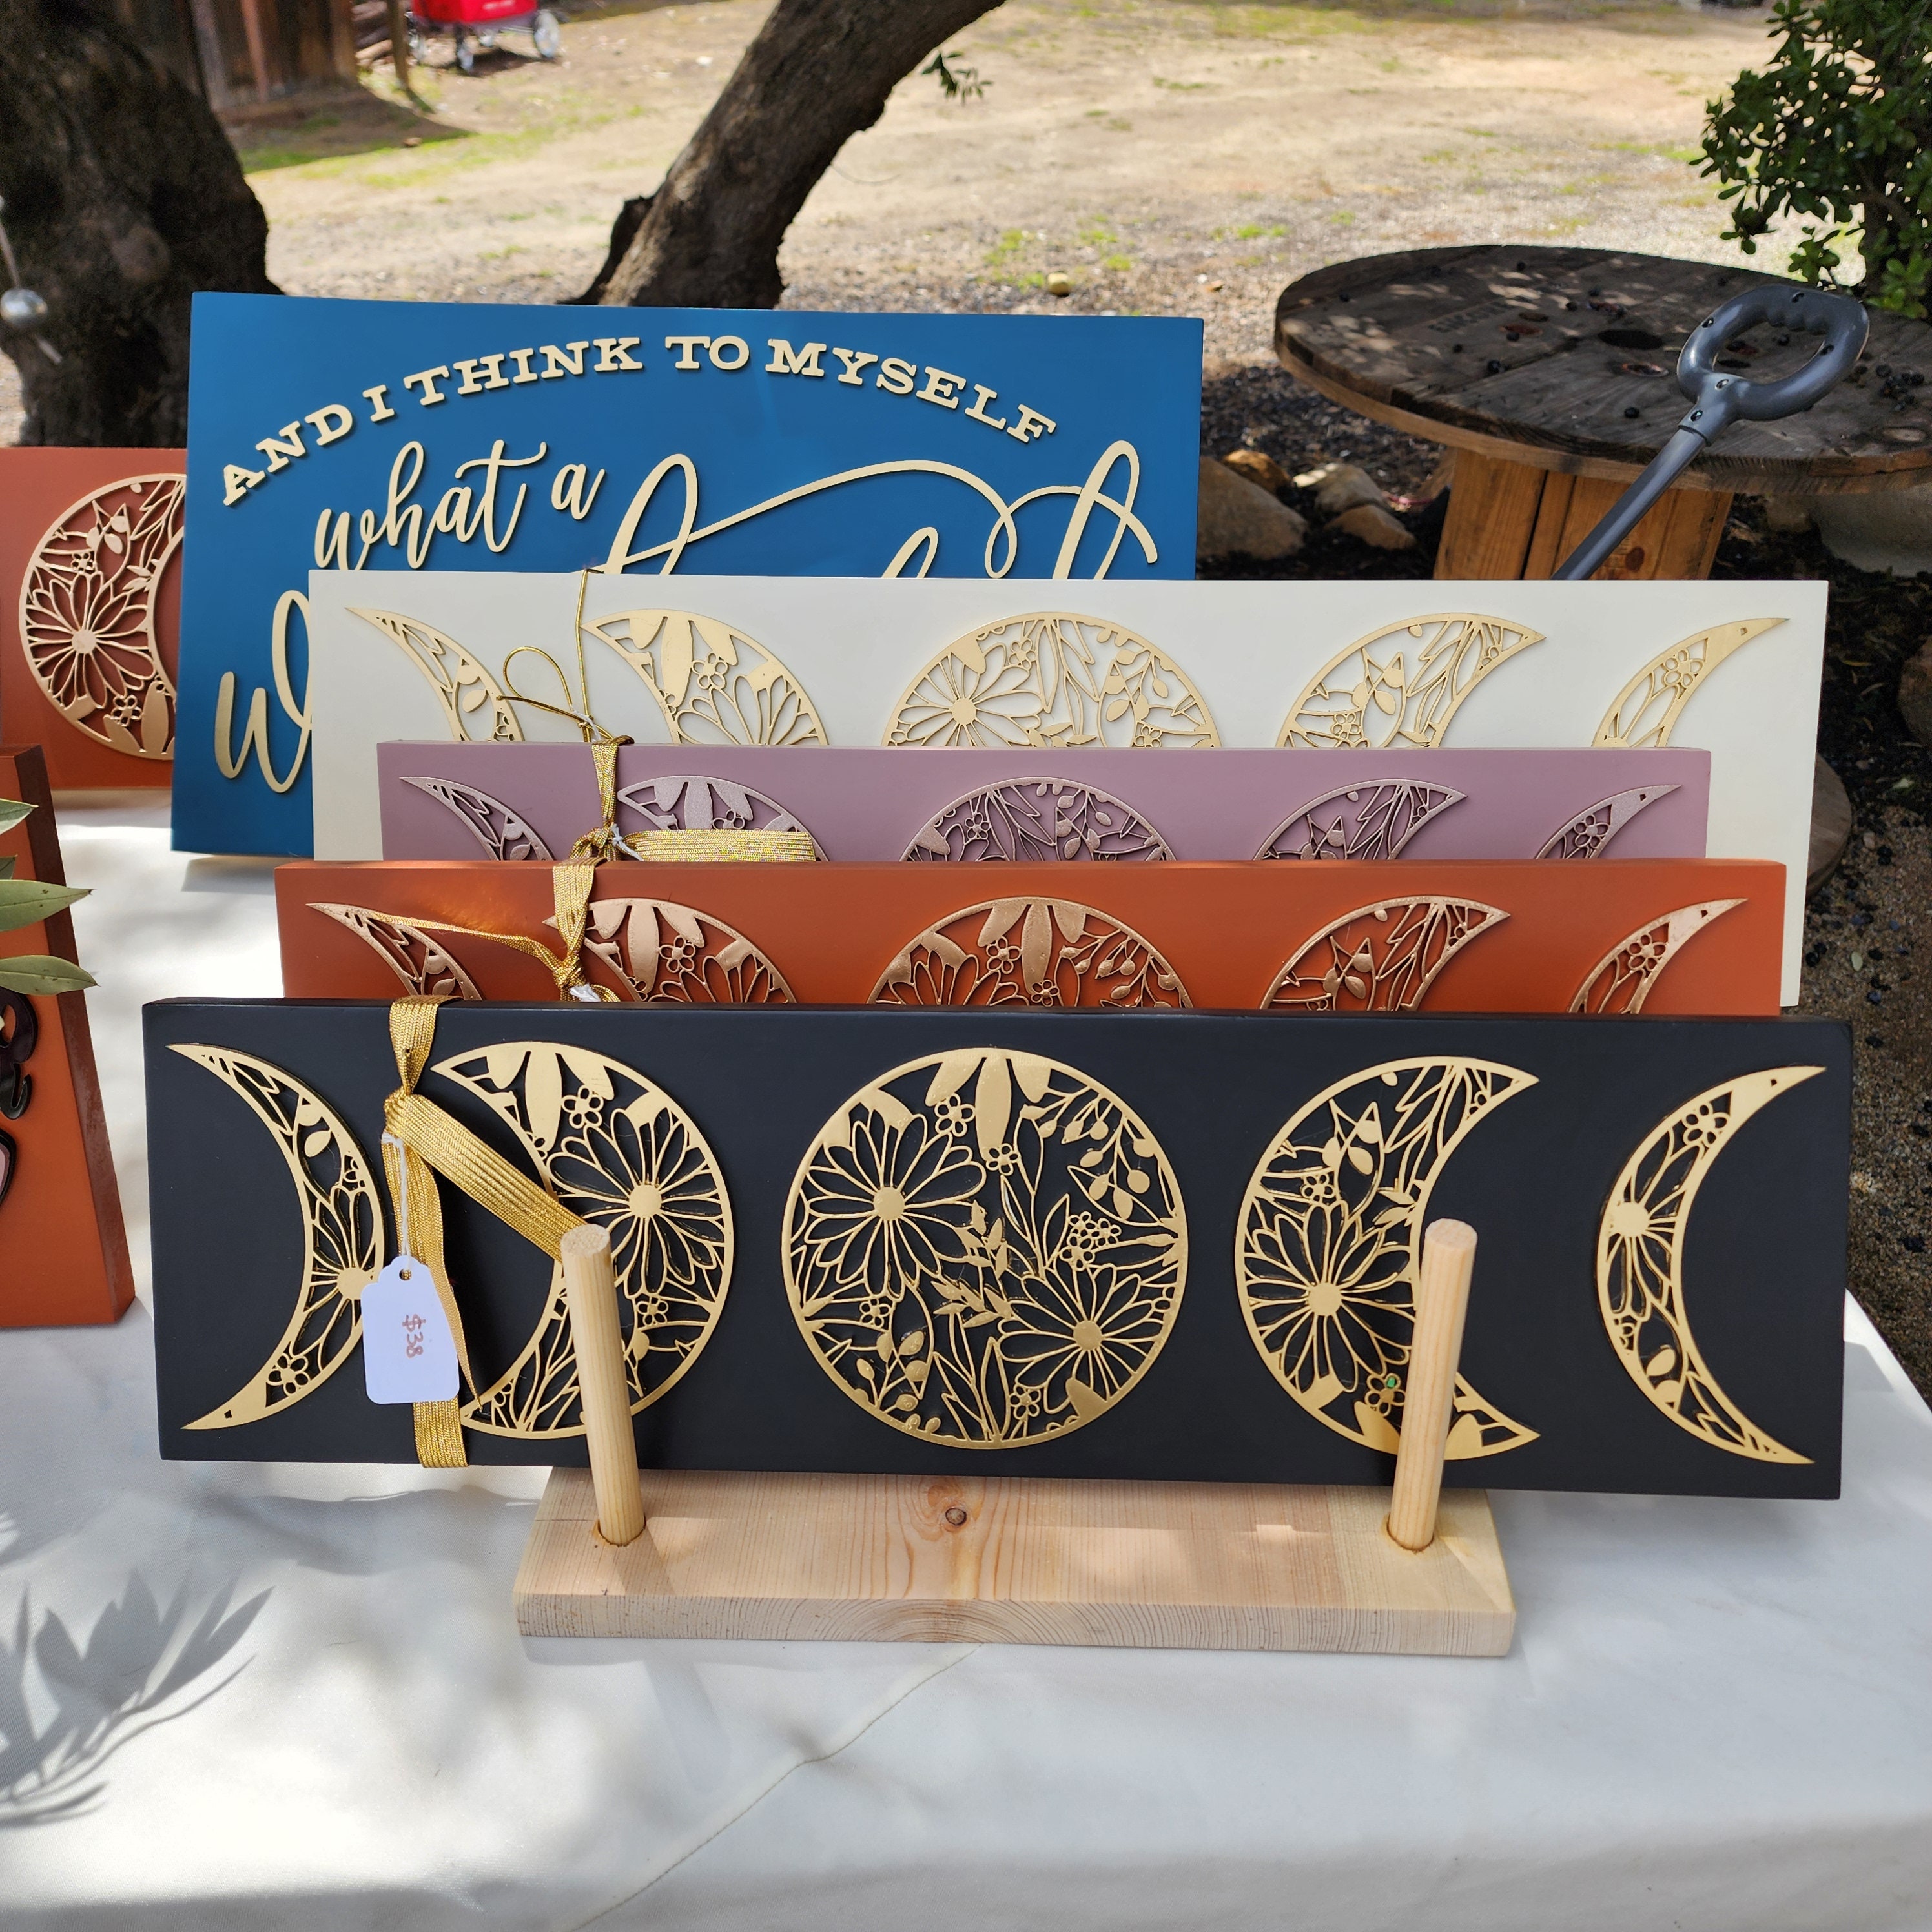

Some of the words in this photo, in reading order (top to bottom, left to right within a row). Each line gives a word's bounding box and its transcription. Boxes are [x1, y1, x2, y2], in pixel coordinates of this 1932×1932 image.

[223, 403, 354, 507] AND
[362, 384, 395, 423] I
[404, 336, 643, 406] THINK
[665, 336, 750, 371] TO
[765, 338, 1057, 444] MYSELF
[314, 439, 548, 571] what
[551, 464, 606, 520] a
[402, 1313, 426, 1359] $38
